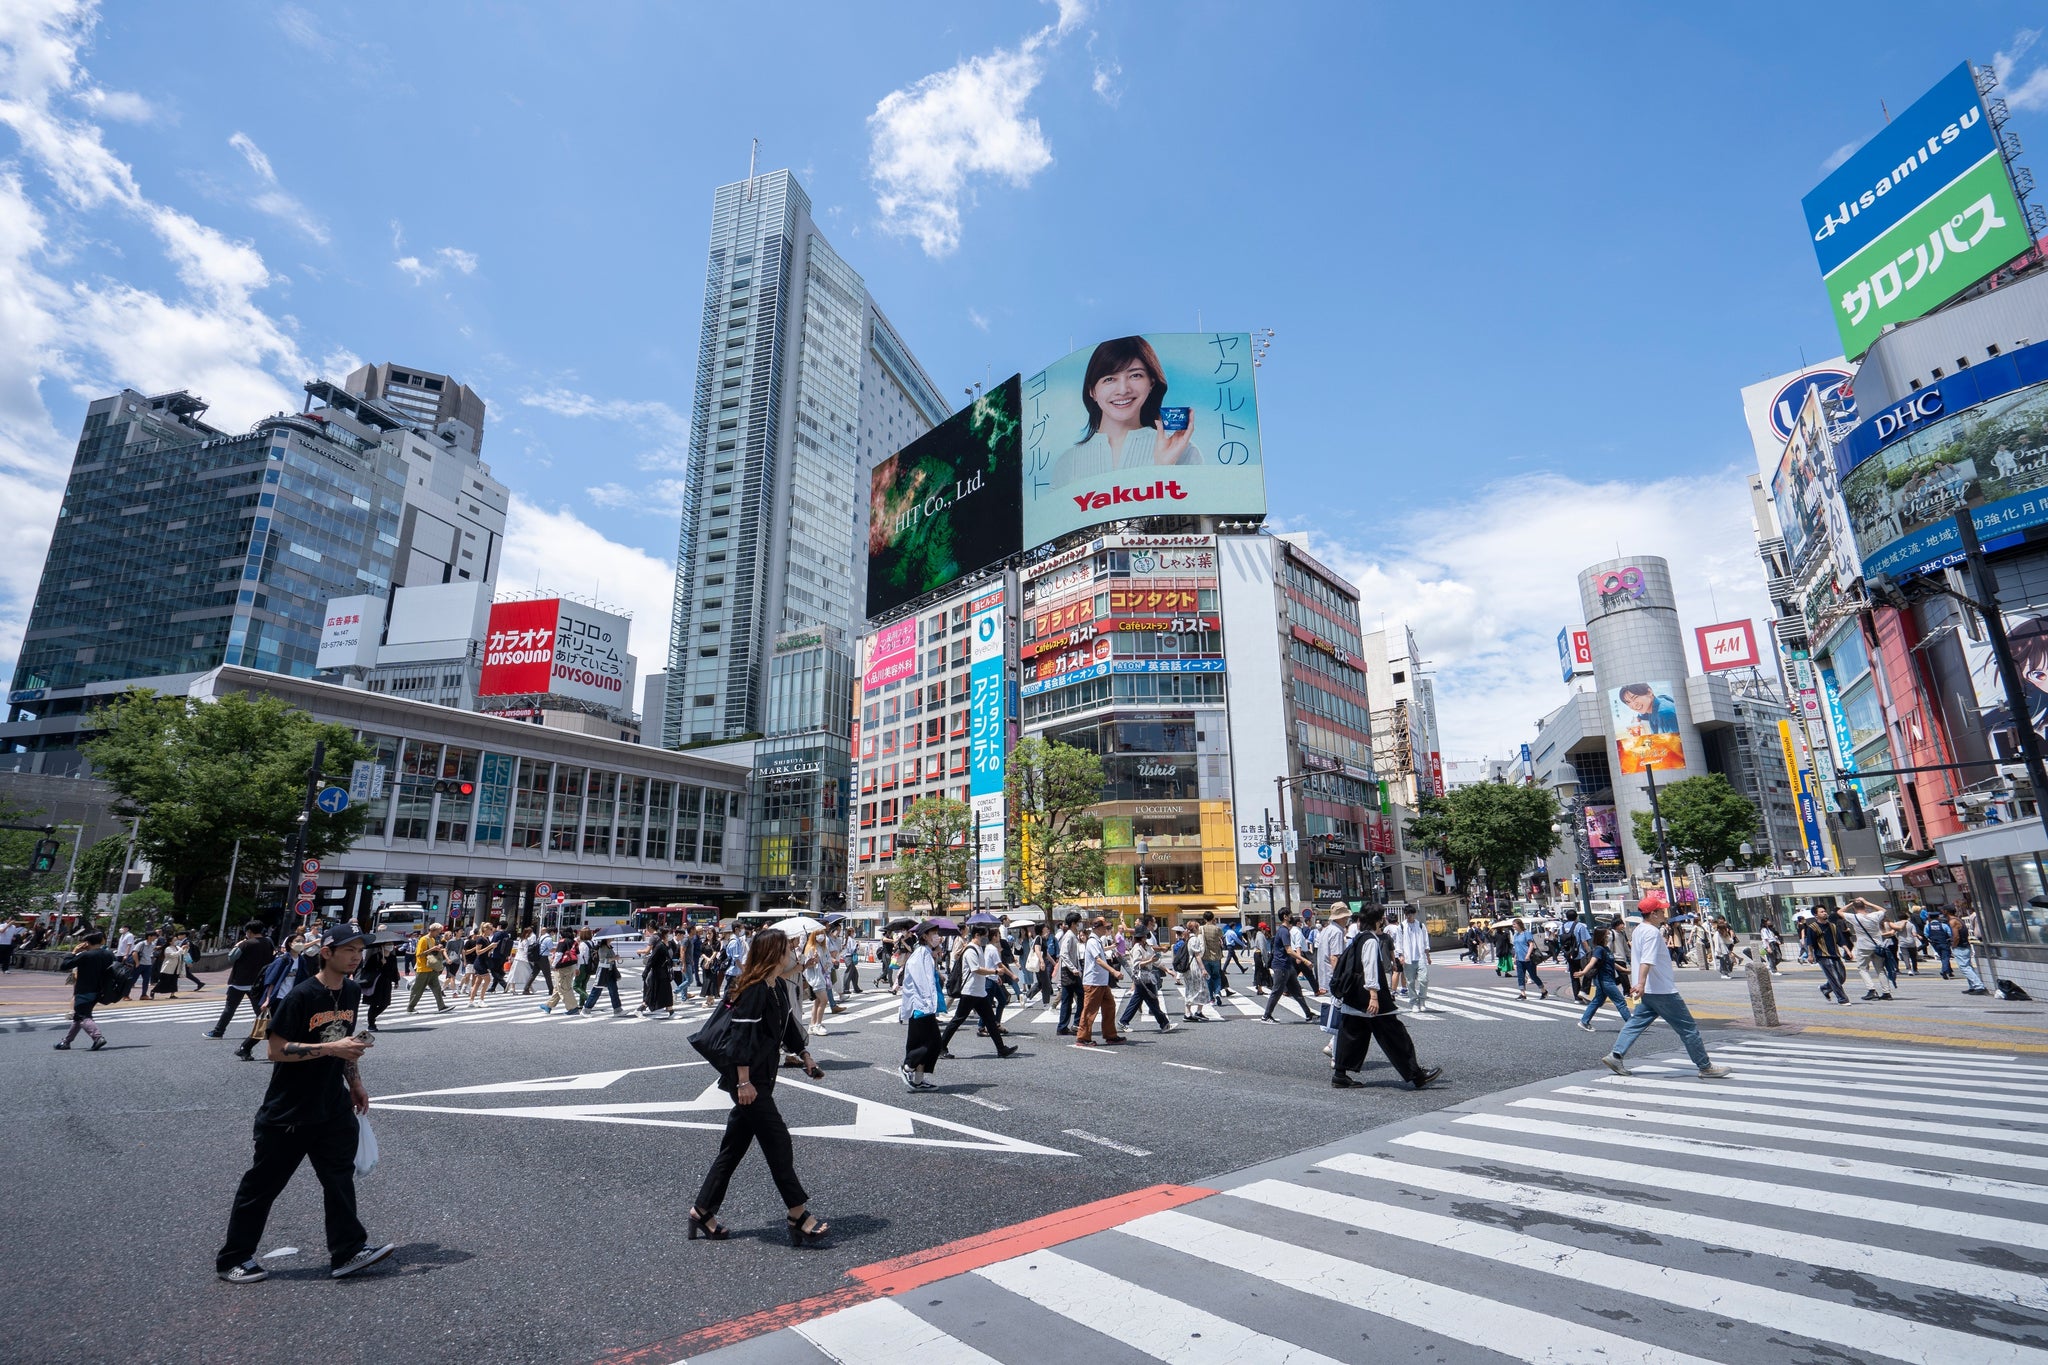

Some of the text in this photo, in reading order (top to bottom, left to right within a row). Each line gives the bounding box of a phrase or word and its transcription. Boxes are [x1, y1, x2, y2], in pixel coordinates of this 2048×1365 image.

[1815, 105, 1980, 242] Hisamitsu
[1841, 193, 2006, 327] サロンパス
[1209, 333, 1249, 466] ヤクルトの
[1874, 389, 1943, 440] DHC
[212, 430, 268, 447] FUKURAS
[1028, 371, 1050, 501] ヨーグルト
[895, 504, 921, 534] HIT
[956, 469, 985, 501] Ltd.
[1073, 480, 1188, 512] Yakult
[1121, 536, 1210, 546] しゃぶしゃぶバイキング
[1160, 553, 1213, 569] しゃぶ葉
[1920, 559, 1942, 575] DHC
[1055, 564, 1090, 589] しゃぶ葉
[1591, 567, 1645, 599] 109
[1024, 589, 1035, 600] 9F
[1111, 592, 1195, 607] コンタクト
[559, 616, 611, 643] ココロの
[1119, 617, 1210, 632] Caféレストラン ガスト
[489, 628, 552, 650] カラオケ
[1070, 625, 1097, 646] ガスト
[1714, 636, 1739, 655] H&M
[486, 649, 551, 666] JOYSOUND
[1056, 648, 1090, 674] ガスト
[1148, 661, 1223, 671] 英会話イーオン
[552, 664, 622, 692] JOYSOUND
[1025, 666, 1036, 679] 7F
[1044, 669, 1094, 690] 英会話イーオン
[505, 709, 531, 717] JOYSOUND
[989, 674, 1000, 771] コンタクトの
[974, 678, 988, 773] アイシティ
[1827, 689, 1853, 772] サマーフルーツギフ
[759, 761, 820, 776] MARK CITY
[773, 757, 803, 766] SHIBUYA
[357, 764, 370, 798] 渋谷駅前
[977, 798, 997, 806] CONTACT
[1135, 805, 1184, 814] L'OCCITANE
[1803, 798, 1813, 823] MIZUHO
[1152, 852, 1171, 861] Café
[1091, 893, 1155, 906] L'OCCITAE
